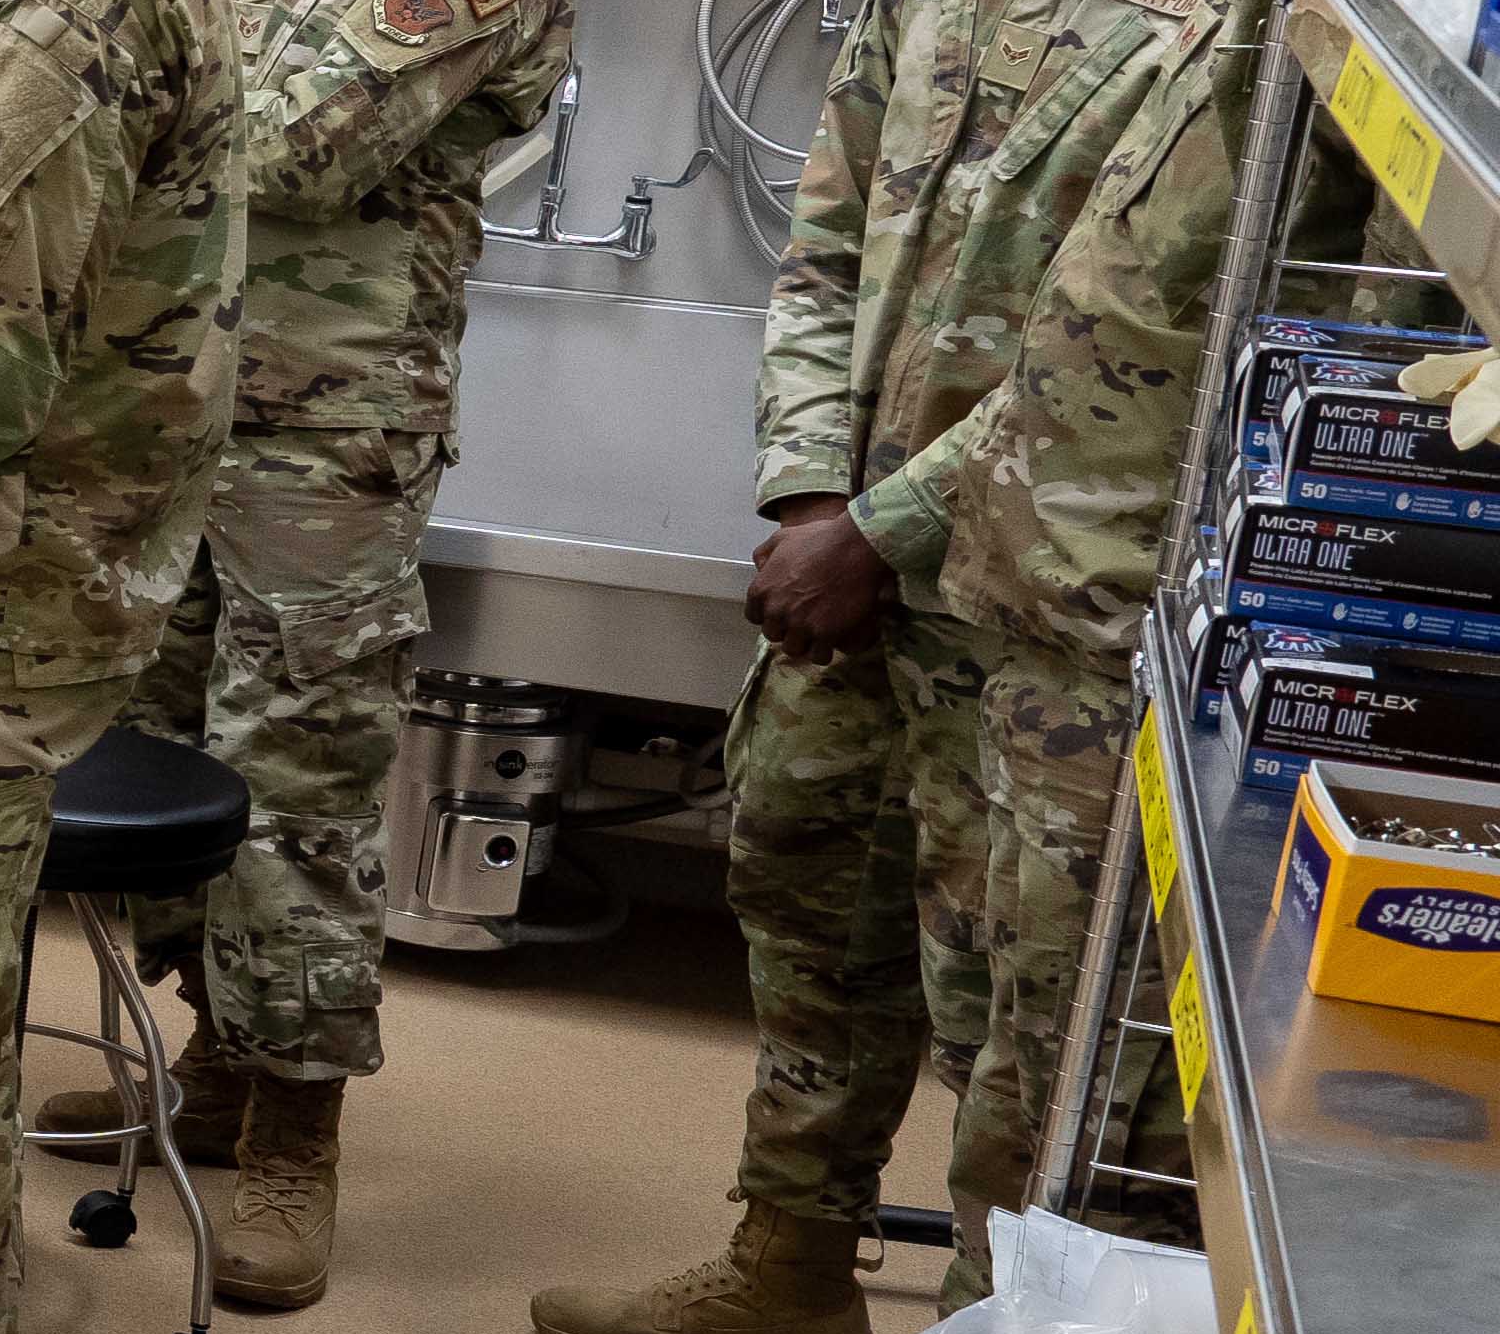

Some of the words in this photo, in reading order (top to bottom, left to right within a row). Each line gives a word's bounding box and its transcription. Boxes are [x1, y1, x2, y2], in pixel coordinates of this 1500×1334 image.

[1314, 423, 1375, 455] ULTRA
[1301, 482, 1328, 499] 50
[1258, 515, 1397, 544] MICROFLEX
[1253, 533, 1312, 565] ULTRA
[1239, 590, 1266, 608] 50
[1274, 679, 1419, 712] MICROFLEX
[1268, 698, 1329, 731] ULTRA
[1254, 758, 1280, 775] 50
[1412, 895, 1500, 916] SUPPLY
